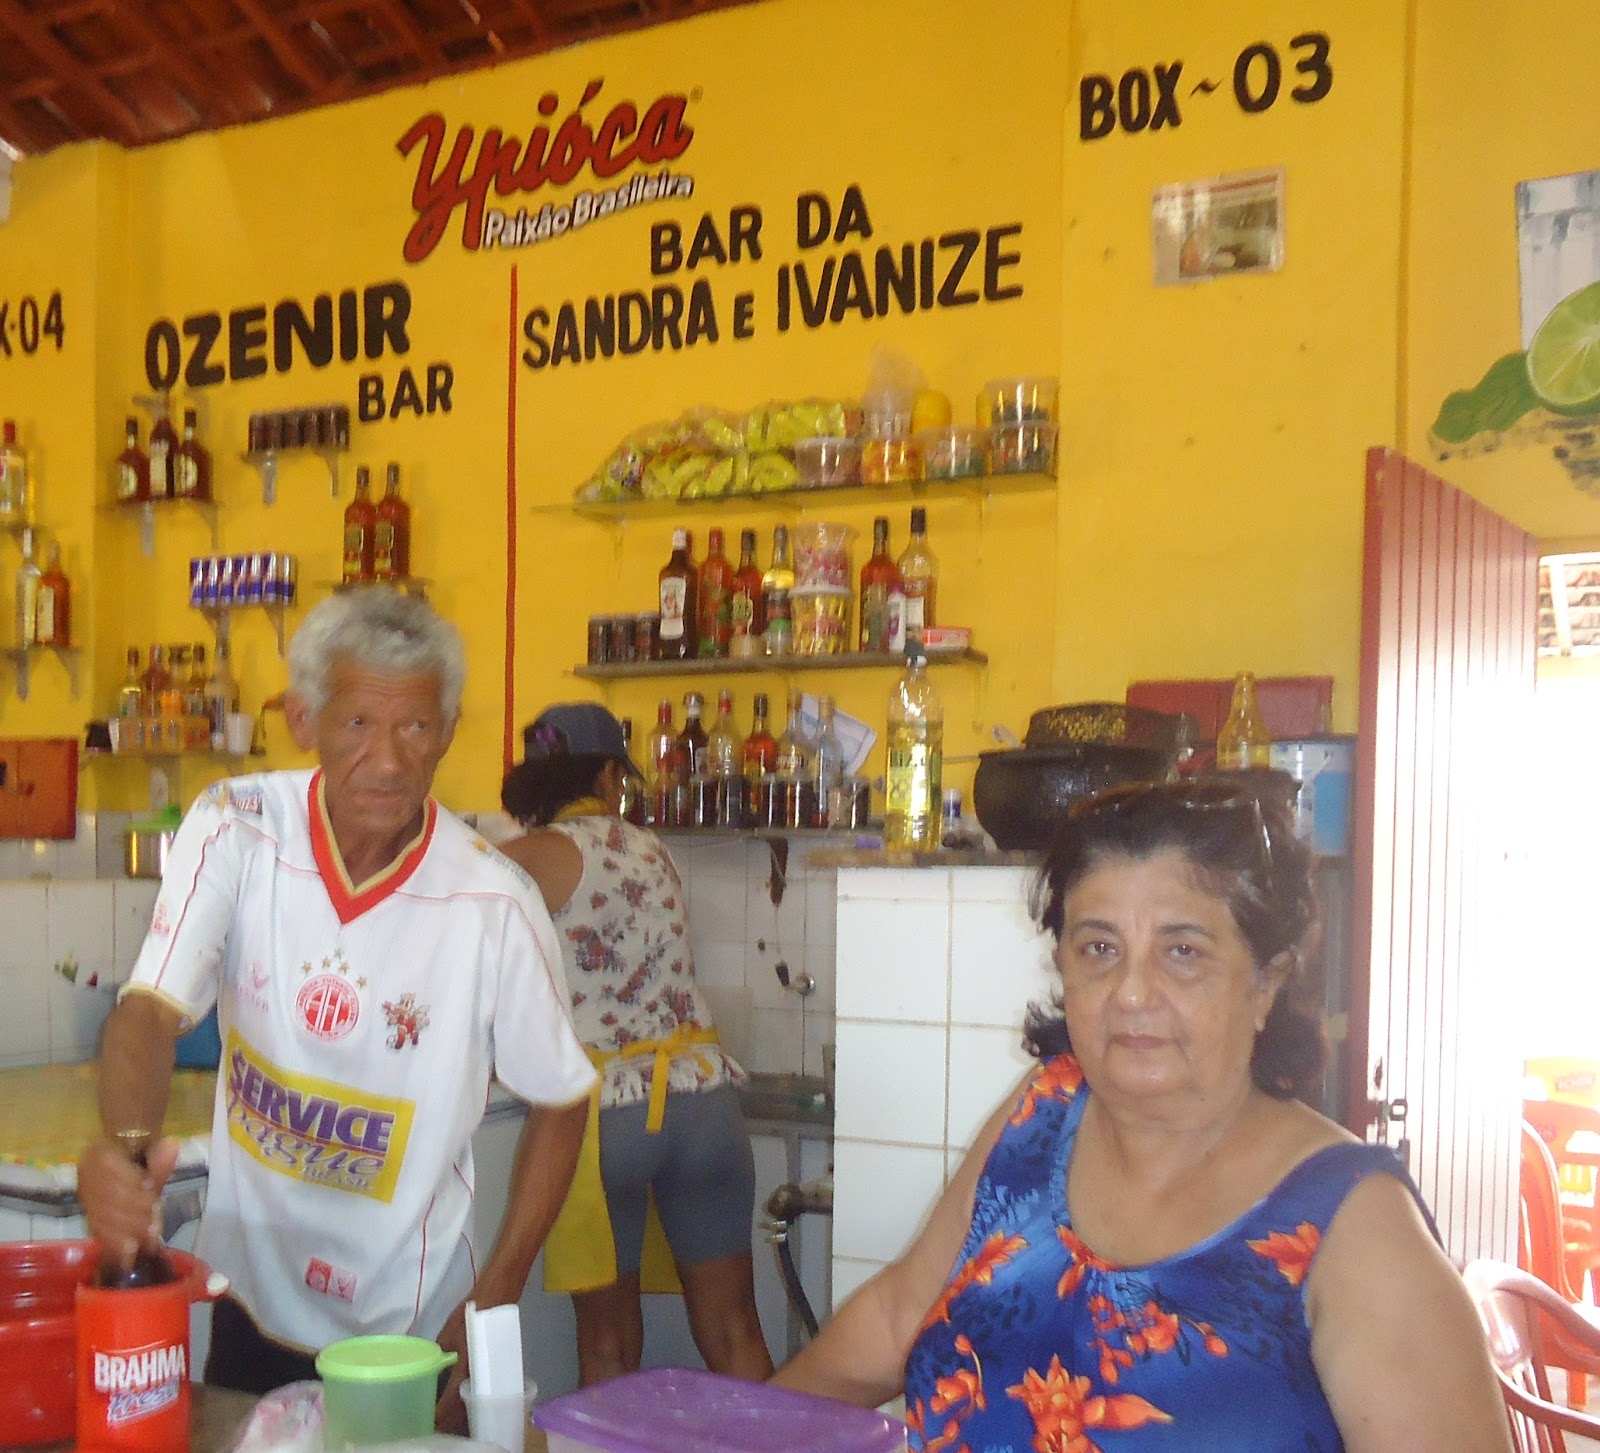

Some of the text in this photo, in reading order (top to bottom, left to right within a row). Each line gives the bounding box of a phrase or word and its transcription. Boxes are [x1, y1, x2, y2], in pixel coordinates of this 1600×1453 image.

[1079, 60, 1183, 141] BOX
[1233, 32, 1334, 114] 03
[397, 78, 694, 262] Ypióca
[484, 171, 694, 249] Paixão Brasileira
[650, 183, 873, 276] BAR DA
[145, 281, 411, 390] OZENIR
[522, 224, 1024, 368] SANDRA E IVANIZE
[358, 362, 454, 422] BAR
[230, 1048, 396, 1154] SERVICE
[94, 1344, 187, 1392] BRAHMA
